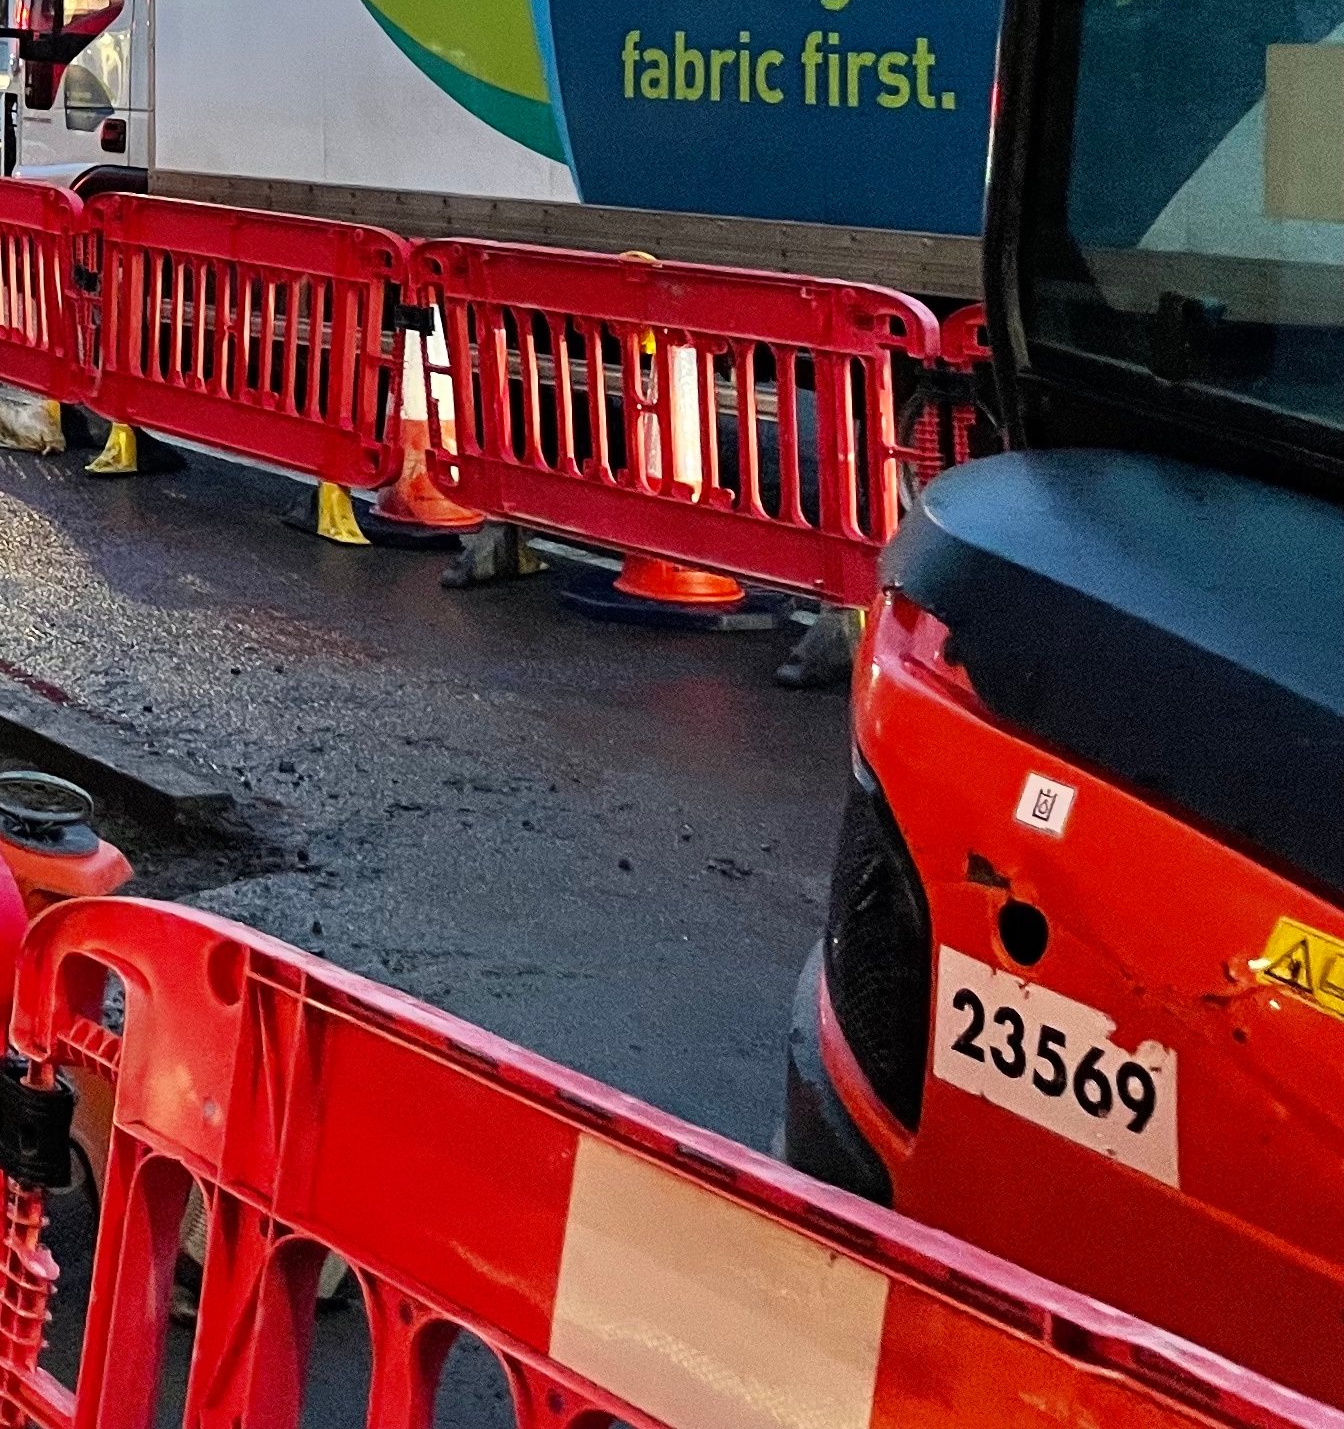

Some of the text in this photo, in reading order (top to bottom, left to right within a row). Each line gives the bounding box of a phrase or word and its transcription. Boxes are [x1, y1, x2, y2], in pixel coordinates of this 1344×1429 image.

[622, 29, 956, 110] fabric first.
[950, 987, 1158, 1134] 23569
